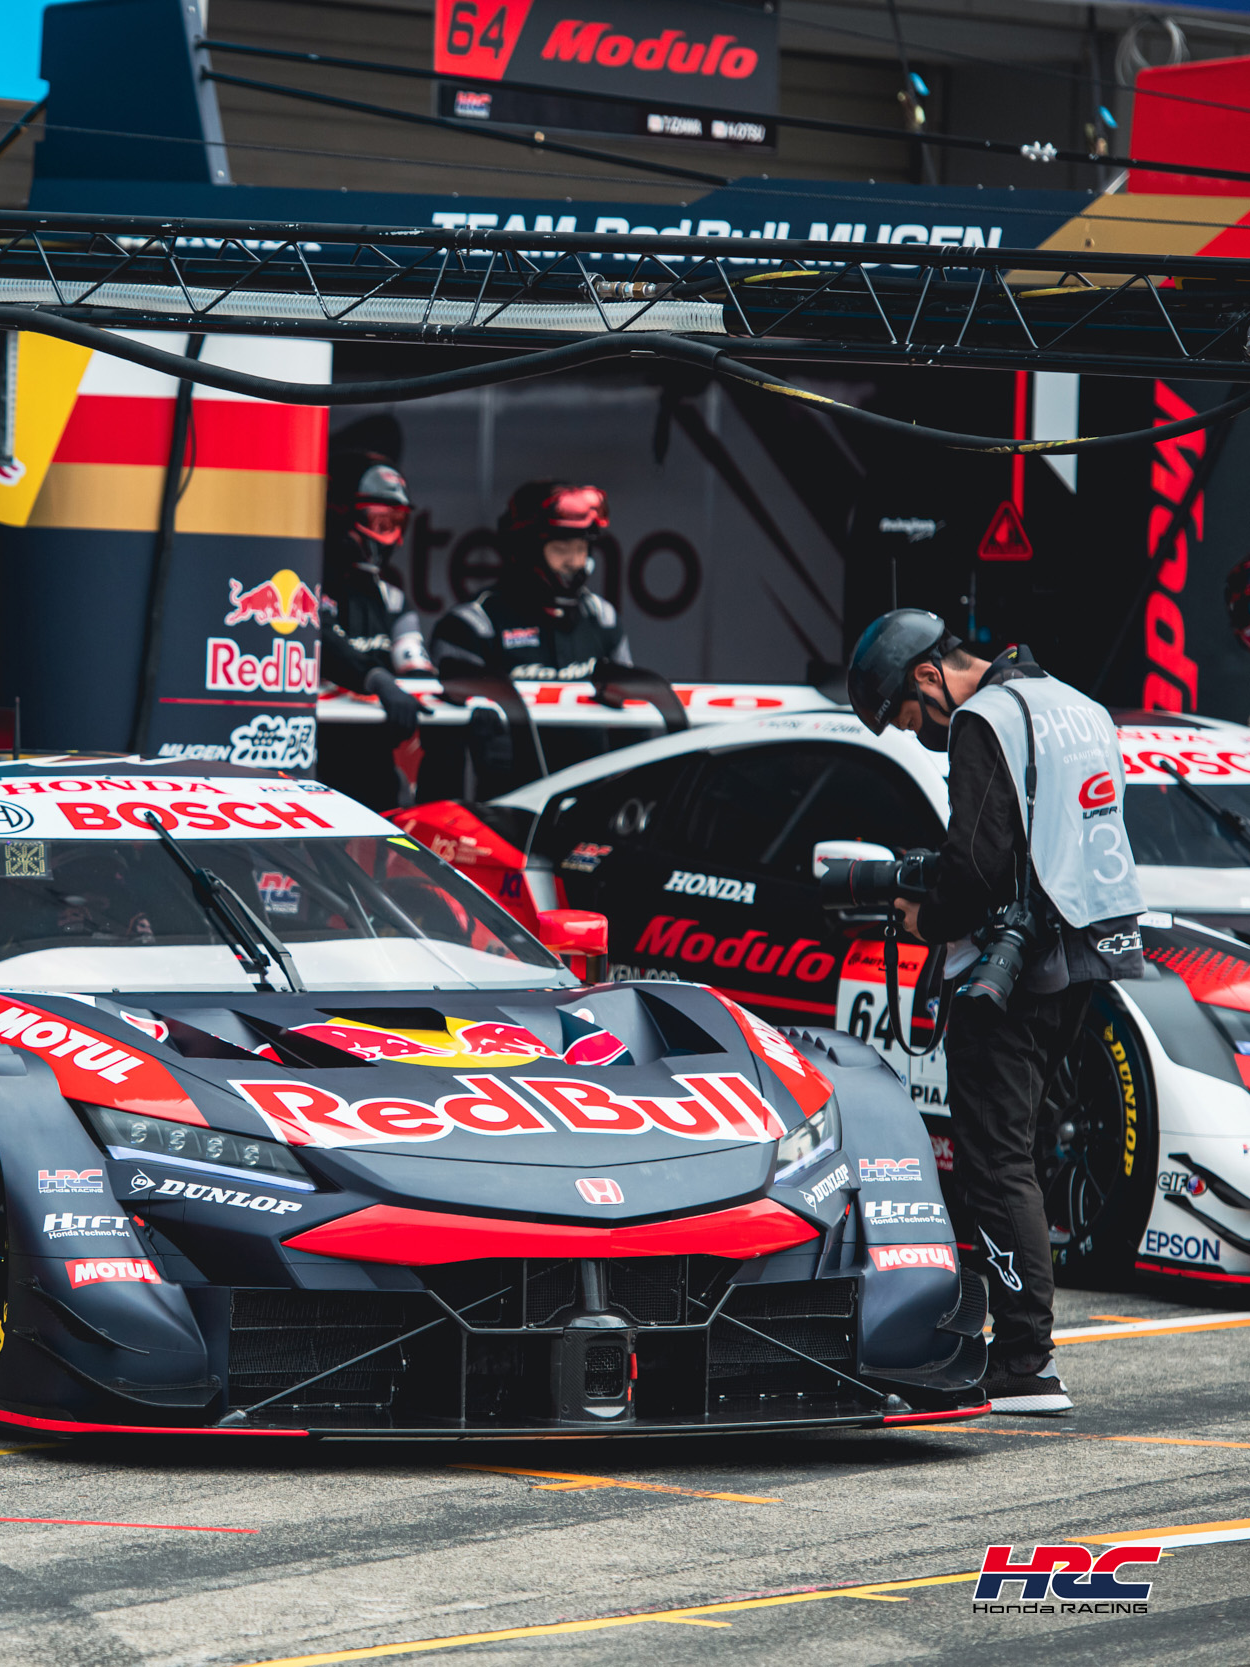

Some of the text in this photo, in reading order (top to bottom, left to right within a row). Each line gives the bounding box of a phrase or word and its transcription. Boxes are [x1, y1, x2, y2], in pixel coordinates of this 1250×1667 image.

[448, 0, 504, 58] 64
[541, 20, 758, 79] Modulo
[158, 744, 231, 760] MUGEN
[56, 801, 334, 831] BOSCH
[663, 870, 757, 904] HONDA
[635, 915, 836, 983] Modulo
[1110, 1040, 1137, 1177] DUNLOP
[38, 1169, 103, 1189] HRC
[858, 1158, 921, 1178] HRC
[811, 1163, 850, 1203] DUNLOP
[1158, 1171, 1190, 1195] elf
[155, 1178, 302, 1215] DUNLOP
[865, 1200, 944, 1219] HTFT
[870, 1217, 899, 1225] Honda
[930, 1216, 946, 1225] Fort
[43, 1213, 129, 1232] HTFT
[49, 1229, 130, 1240] Honda Techno Fort
[878, 1248, 953, 1267] MOTUL
[1146, 1230, 1220, 1261] EPSON
[74, 1262, 156, 1282] MOTUL
